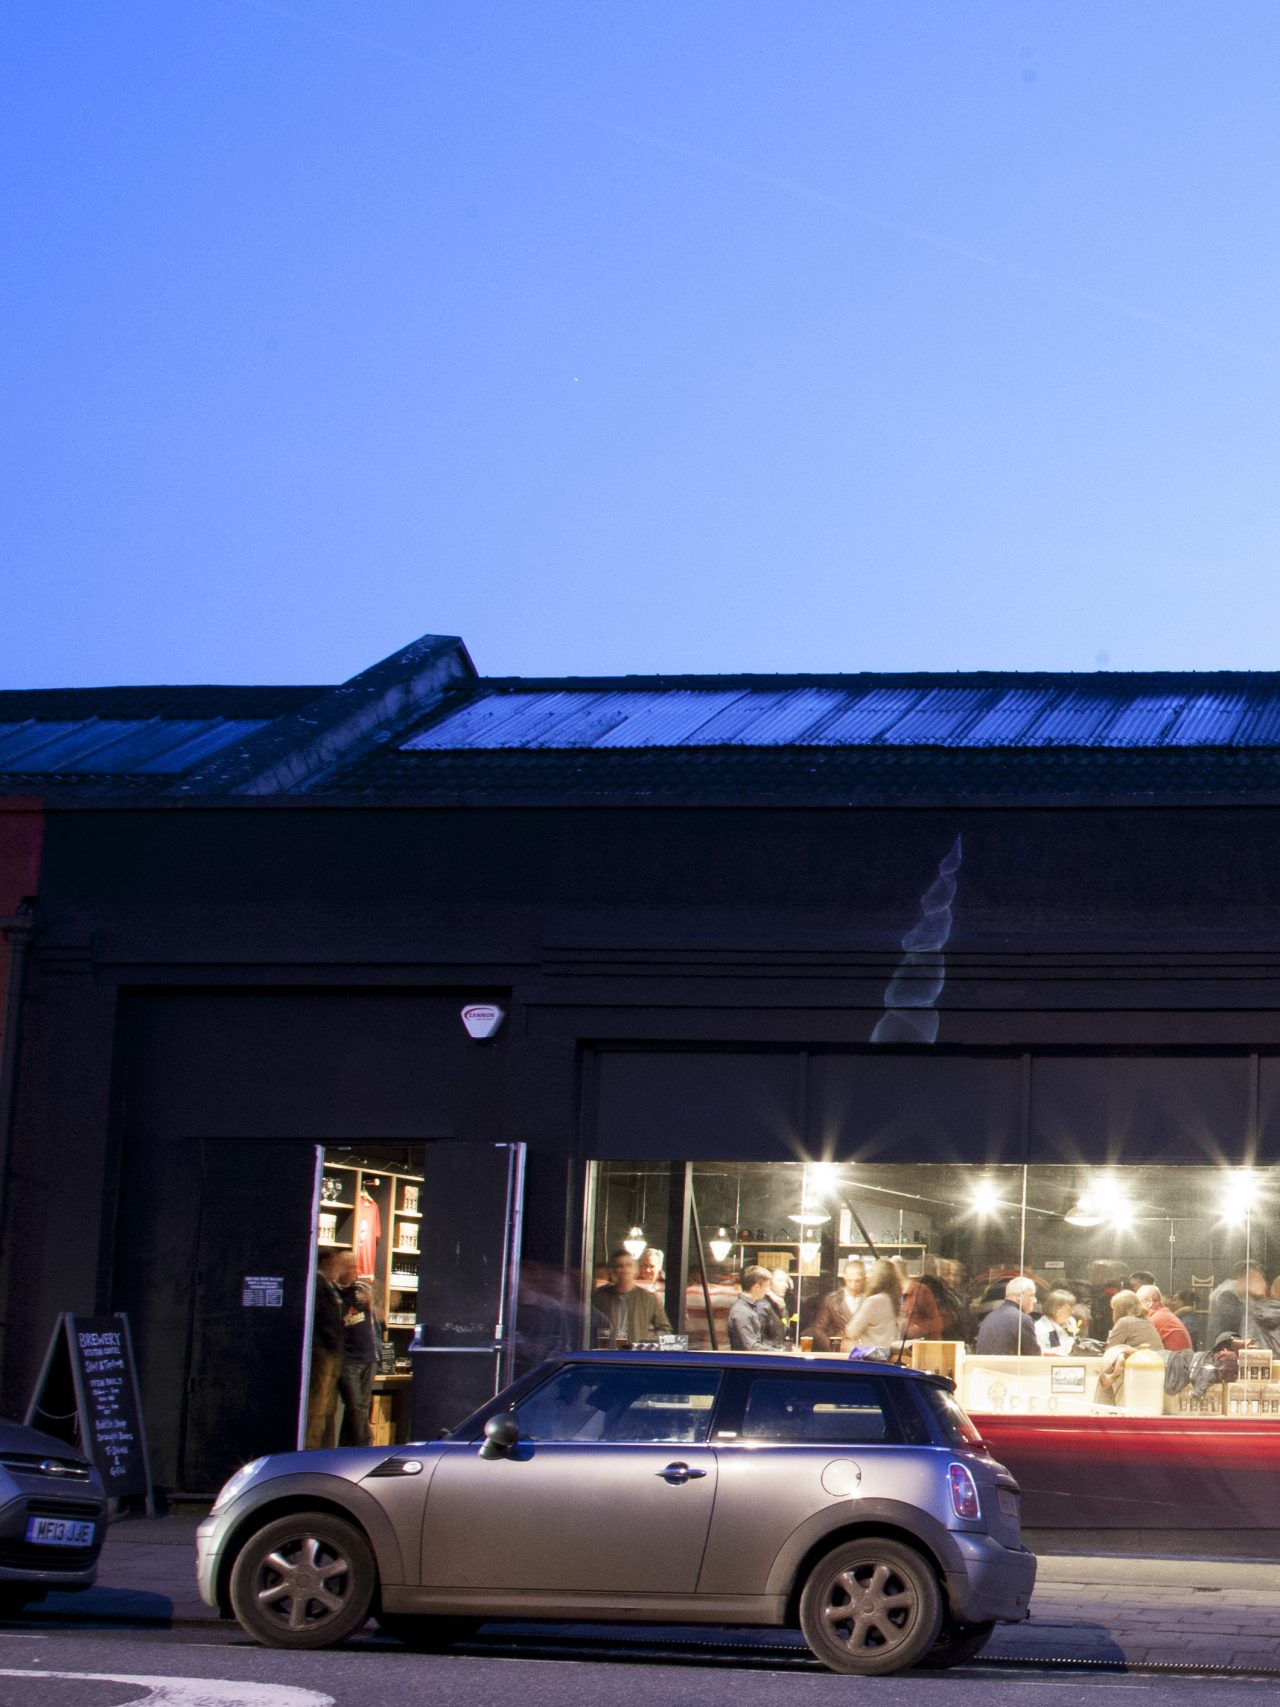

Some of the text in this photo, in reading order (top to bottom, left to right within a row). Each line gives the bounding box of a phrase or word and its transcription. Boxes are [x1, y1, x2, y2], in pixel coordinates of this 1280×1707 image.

[78, 1332, 121, 1347] BREWERY
[36, 1520, 90, 1543] MF13 JJE
